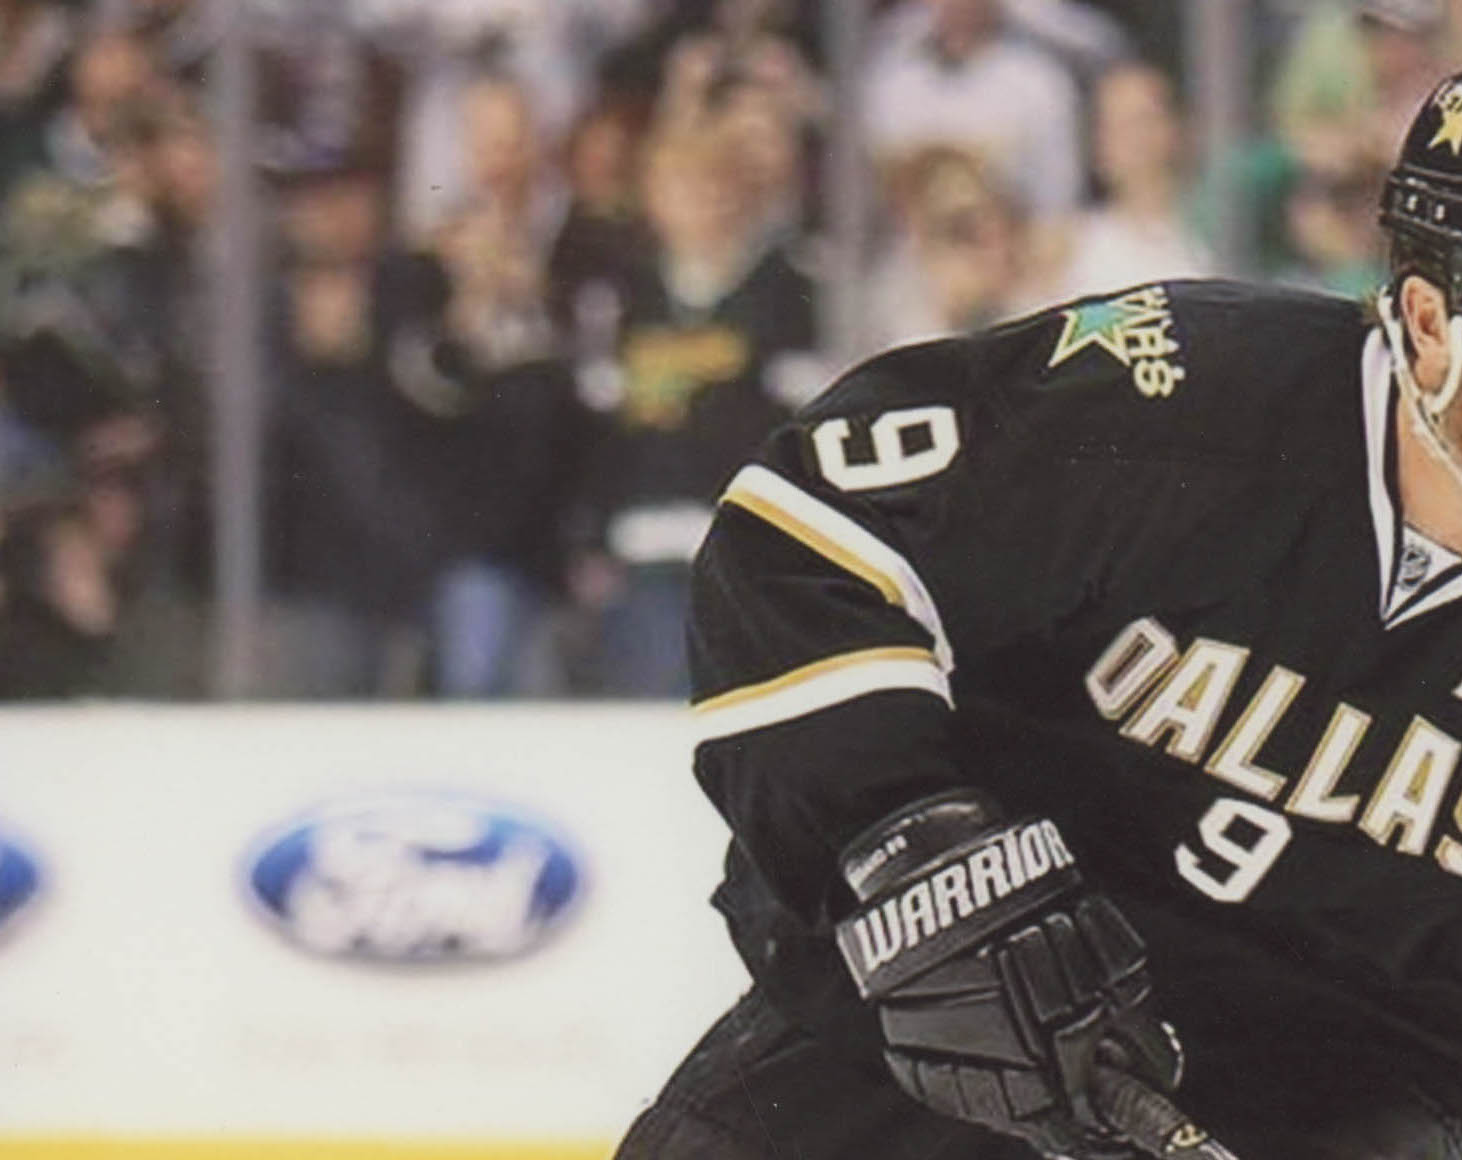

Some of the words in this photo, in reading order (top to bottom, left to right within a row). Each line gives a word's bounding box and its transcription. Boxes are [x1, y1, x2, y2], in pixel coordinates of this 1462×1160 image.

[811, 405, 961, 492] 9
[853, 818, 1075, 973] WARRIOR
[1175, 798, 1293, 903] 9
